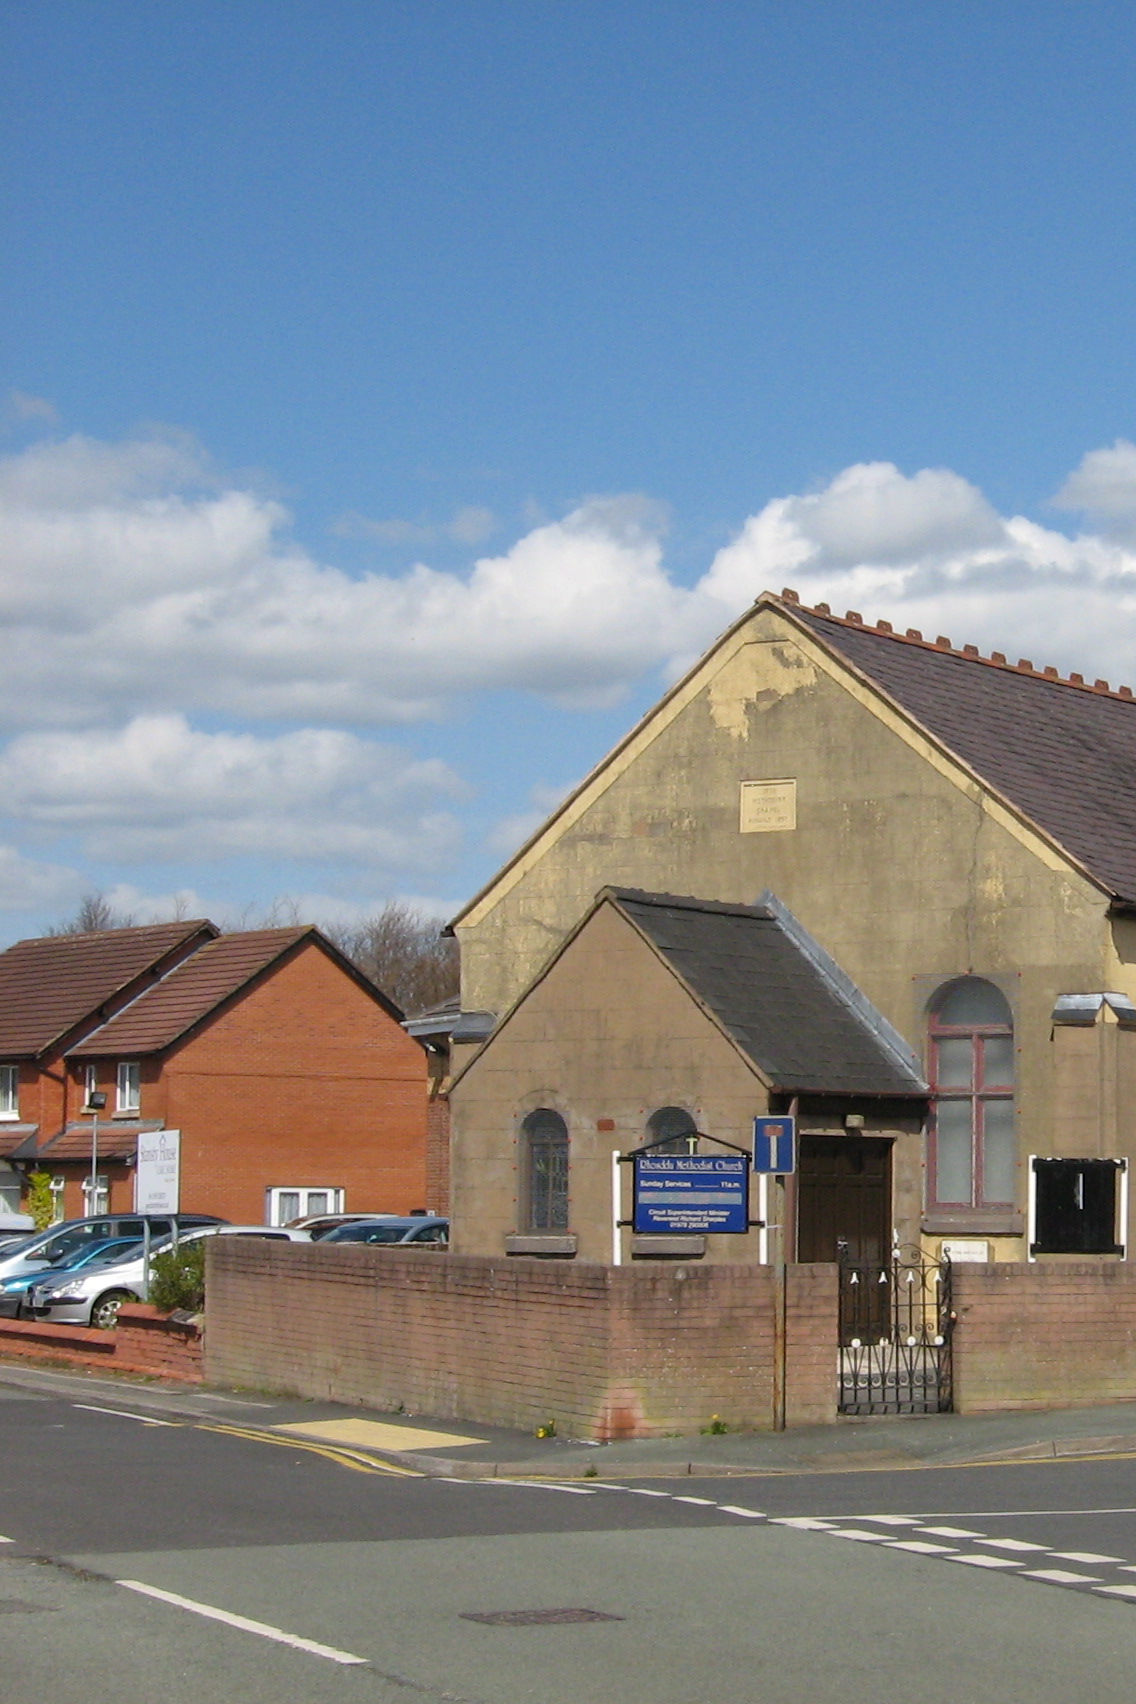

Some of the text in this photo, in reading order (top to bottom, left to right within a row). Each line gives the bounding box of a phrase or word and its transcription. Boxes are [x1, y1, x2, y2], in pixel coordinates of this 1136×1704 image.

[676, 1161, 713, 1170] Methodist
[715, 1161, 743, 1170] Church
[640, 1180, 663, 1188] Sunday
[665, 1180, 691, 1188] Services
